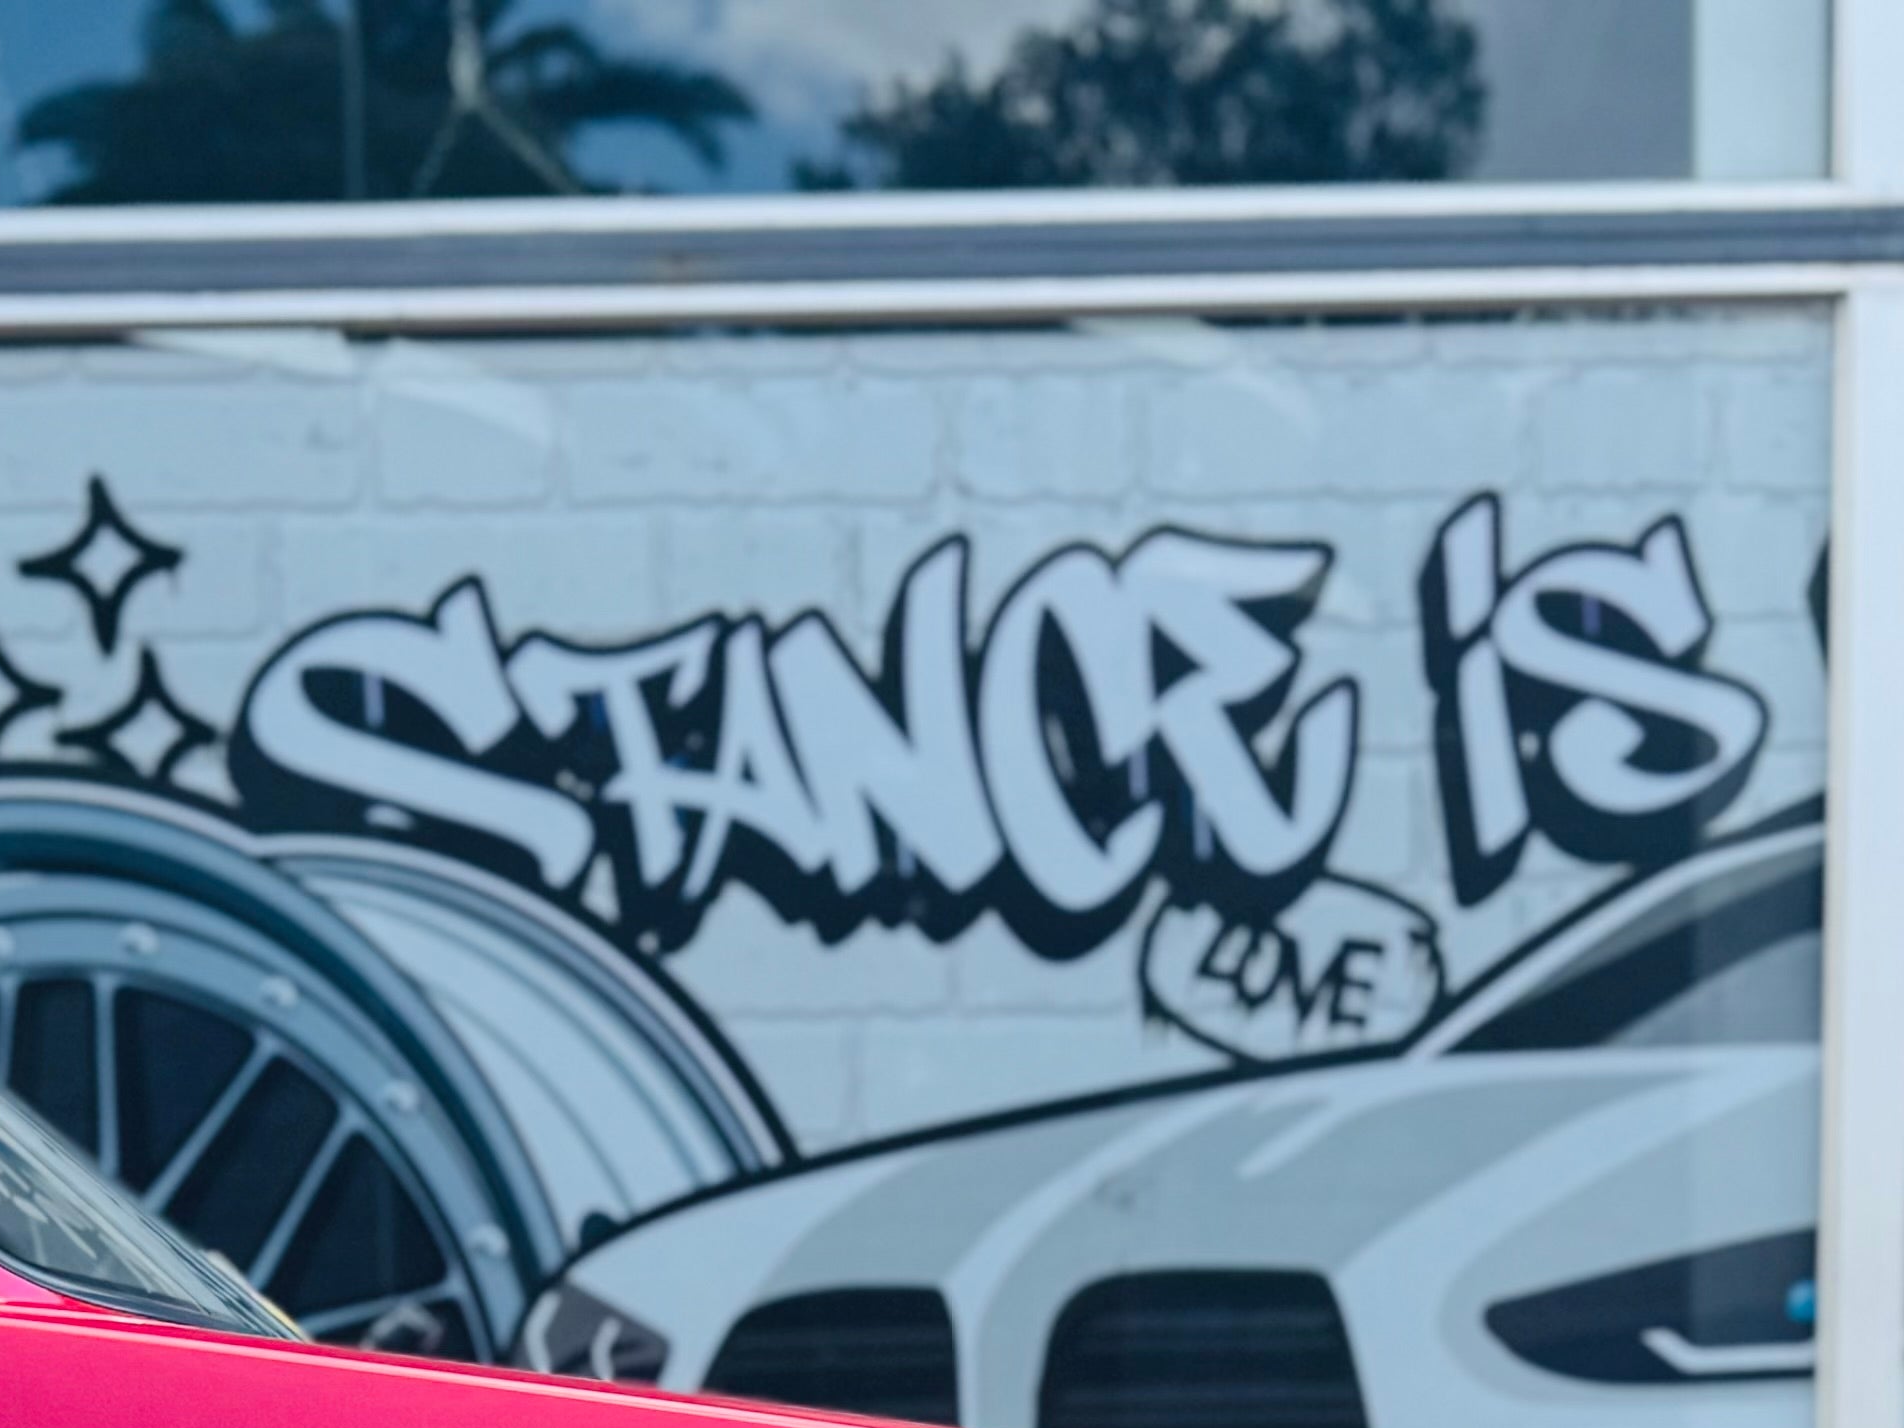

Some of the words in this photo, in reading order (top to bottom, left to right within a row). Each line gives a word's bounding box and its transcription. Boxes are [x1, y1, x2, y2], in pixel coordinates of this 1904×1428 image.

[231, 528, 1360, 962] STANCE
[1420, 490, 1768, 905] IS
[1198, 920, 1384, 1027] LOVE
